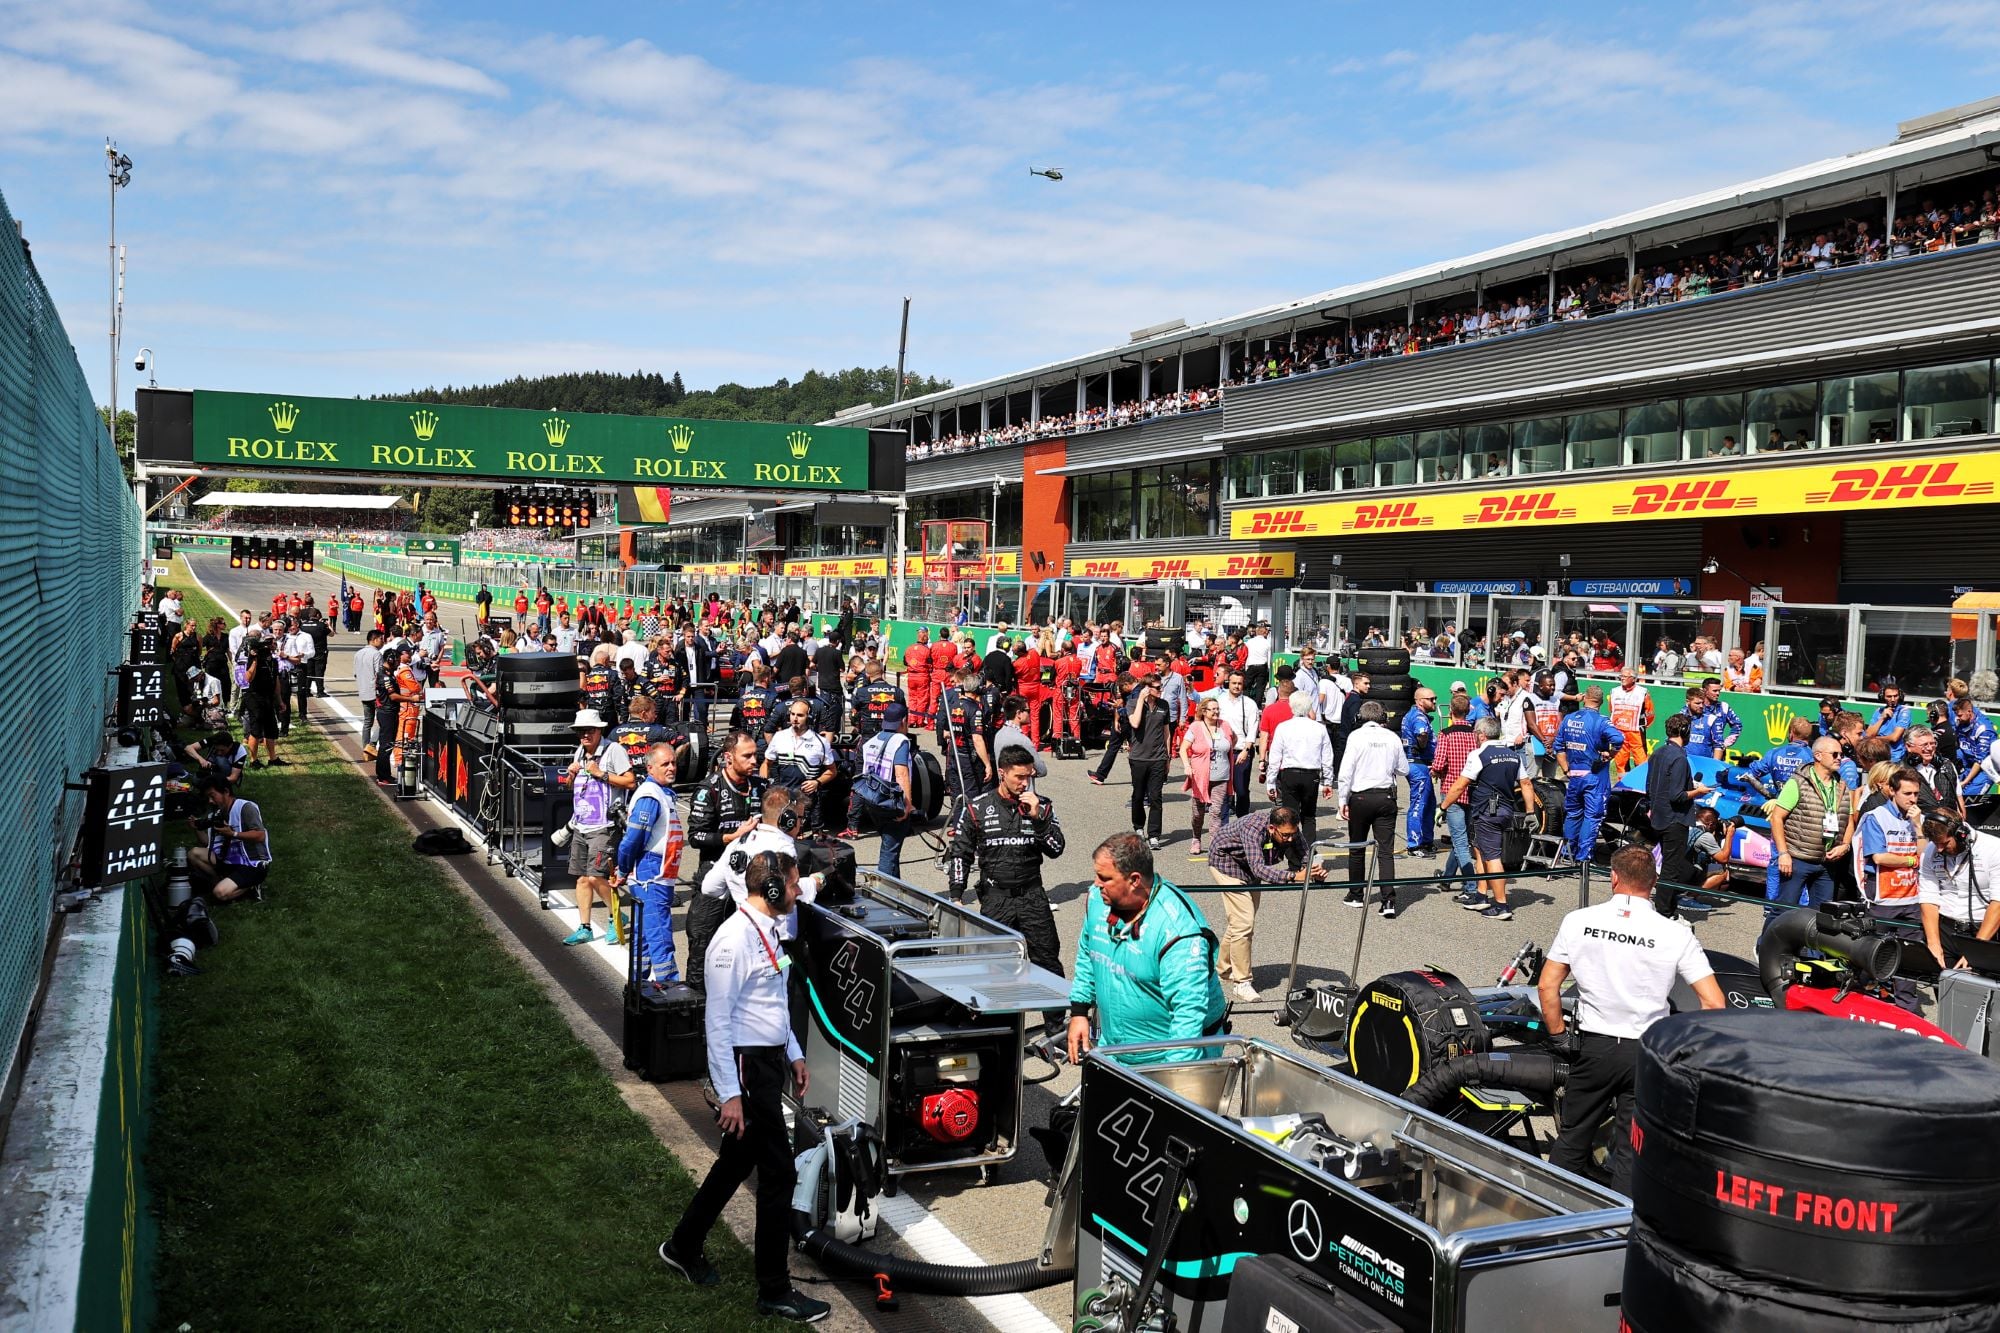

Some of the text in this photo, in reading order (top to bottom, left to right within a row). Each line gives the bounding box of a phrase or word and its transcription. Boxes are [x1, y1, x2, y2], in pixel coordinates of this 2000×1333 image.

[227, 437, 339, 462] ROLEX
[371, 444, 477, 468] ROLEX
[506, 451, 606, 474] ROLEX
[633, 457, 728, 479] ROLEX
[754, 463, 843, 484] ROLEX
[1829, 462, 1967, 503] DHL
[1477, 492, 1560, 523] DHL
[1630, 480, 1737, 514] DHL
[1251, 510, 1307, 534] DHL
[1353, 503, 1421, 529] DHL
[791, 564, 808, 576] DHL
[820, 563, 839, 575] DHL
[854, 561, 873, 574] DHL
[1084, 562, 1121, 578] DHL
[1150, 560, 1192, 579] DHL
[1226, 556, 1275, 576] DHL
[1440, 584, 1516, 593] FERNANDO ALONSO
[1585, 582, 1661, 593] ESTEBAN OCON
[139, 634, 156, 654] 11
[131, 670, 163, 701] 14
[132, 706, 159, 723] ALO
[616, 726, 651, 734] ORACLE
[107, 774, 165, 831] 44
[986, 837, 1036, 847] PETRONAS
[107, 842, 157, 875] HAM
[1891, 877, 1917, 887] LAN
[1583, 926, 1656, 949] PETRONAS
[830, 939, 876, 1031] 44
[1316, 989, 1345, 1018] IWC
[1372, 990, 1402, 1012] PIRELLI
[1097, 1097, 1170, 1228] 44
[1715, 1169, 1899, 1234] LEFT FRONT
[1329, 1240, 1405, 1295] PETRONAS
[1352, 1239, 1405, 1280] AMG
[1338, 1261, 1404, 1309] FORMULA ONE TEAM
